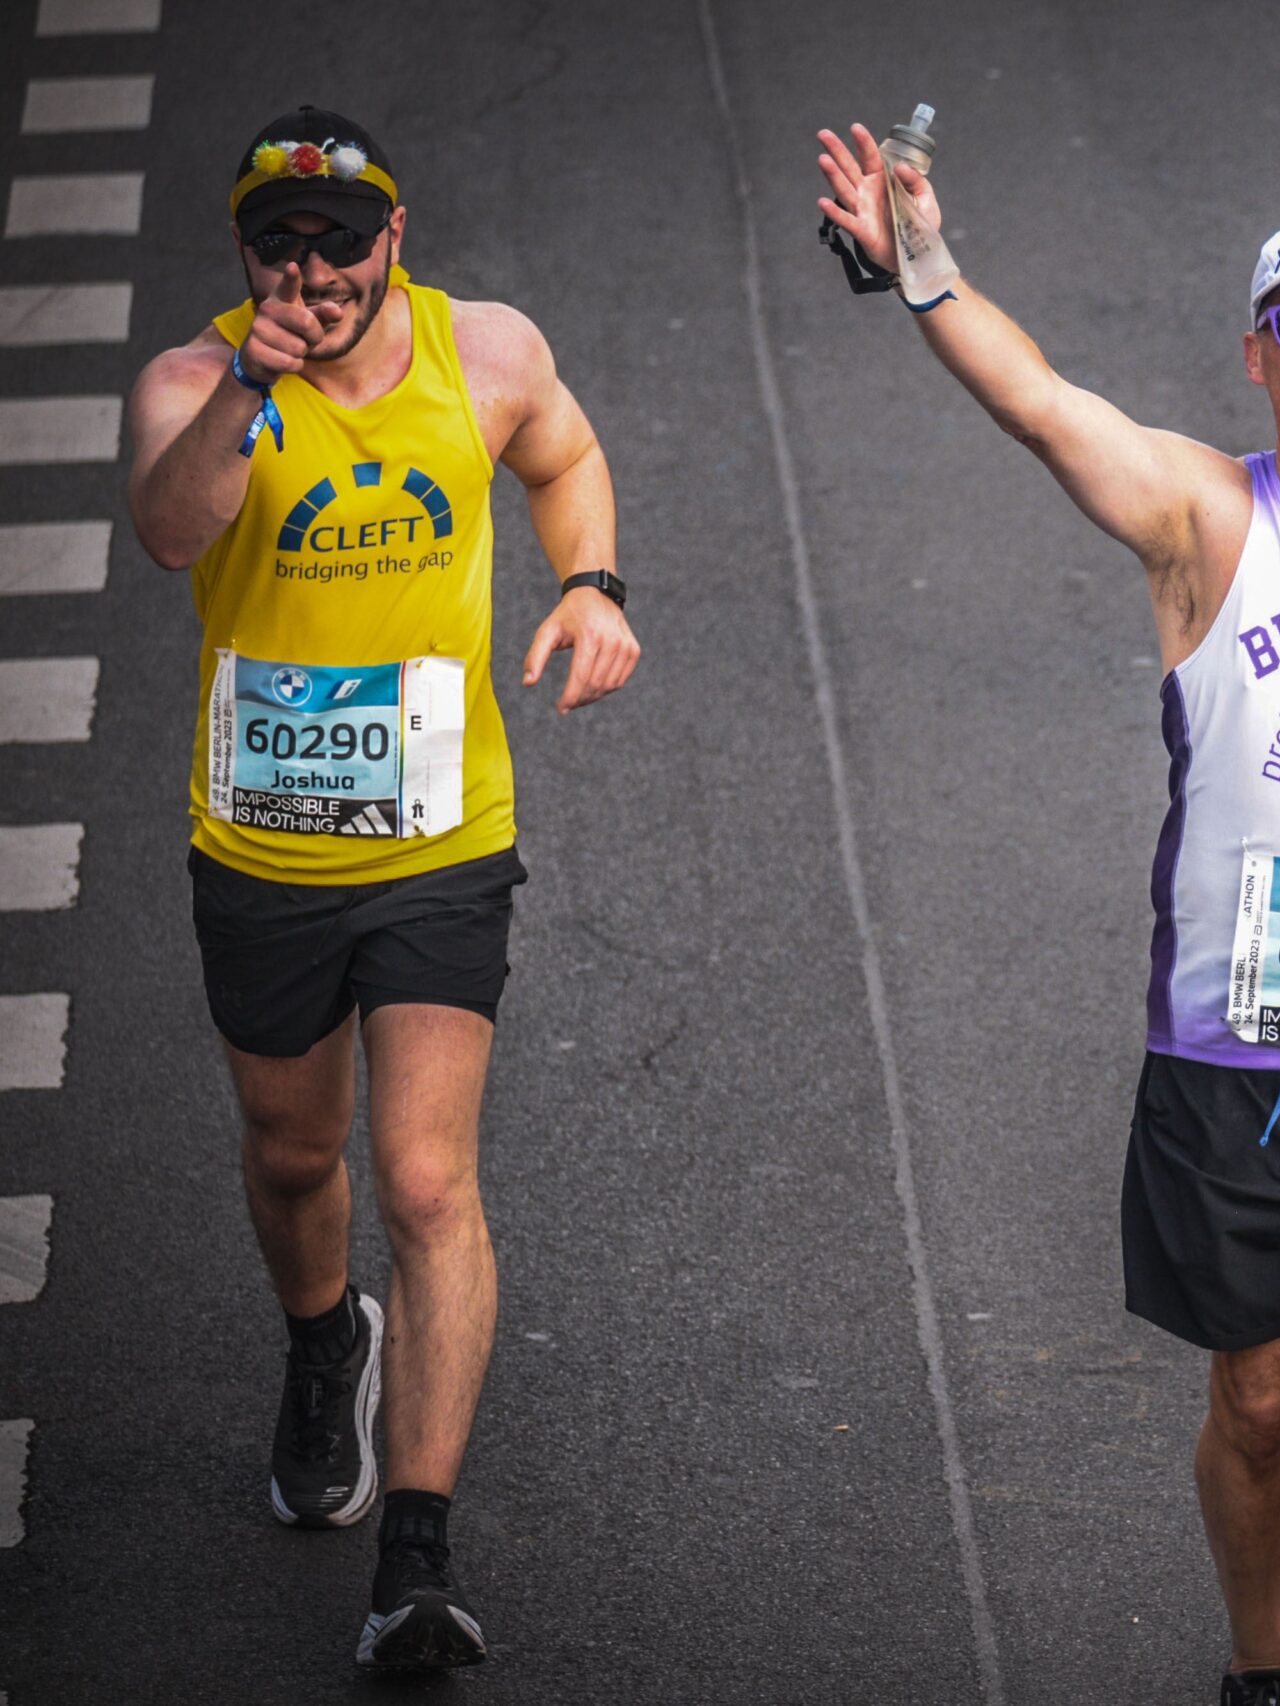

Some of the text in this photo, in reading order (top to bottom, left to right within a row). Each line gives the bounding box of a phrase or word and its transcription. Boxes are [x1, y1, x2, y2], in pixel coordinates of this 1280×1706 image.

[309, 515, 425, 553] CLEFT
[275, 550, 454, 584] bridging the gap
[223, 720, 232, 741] 2023
[410, 715, 422, 731] E
[245, 718, 389, 762] 60290
[212, 761, 221, 786] BMW
[222, 743, 233, 790] September
[270, 769, 356, 791] Joshua
[234, 789, 341, 816] IMPOSSIBLE
[234, 805, 336, 833] IS NOTHING
[1249, 939, 1261, 964] 2023
[1232, 981, 1243, 1008] BMW
[1245, 964, 1258, 1010] September
[1232, 1009, 1242, 1026] 49.
[1261, 1024, 1279, 1042] IS
